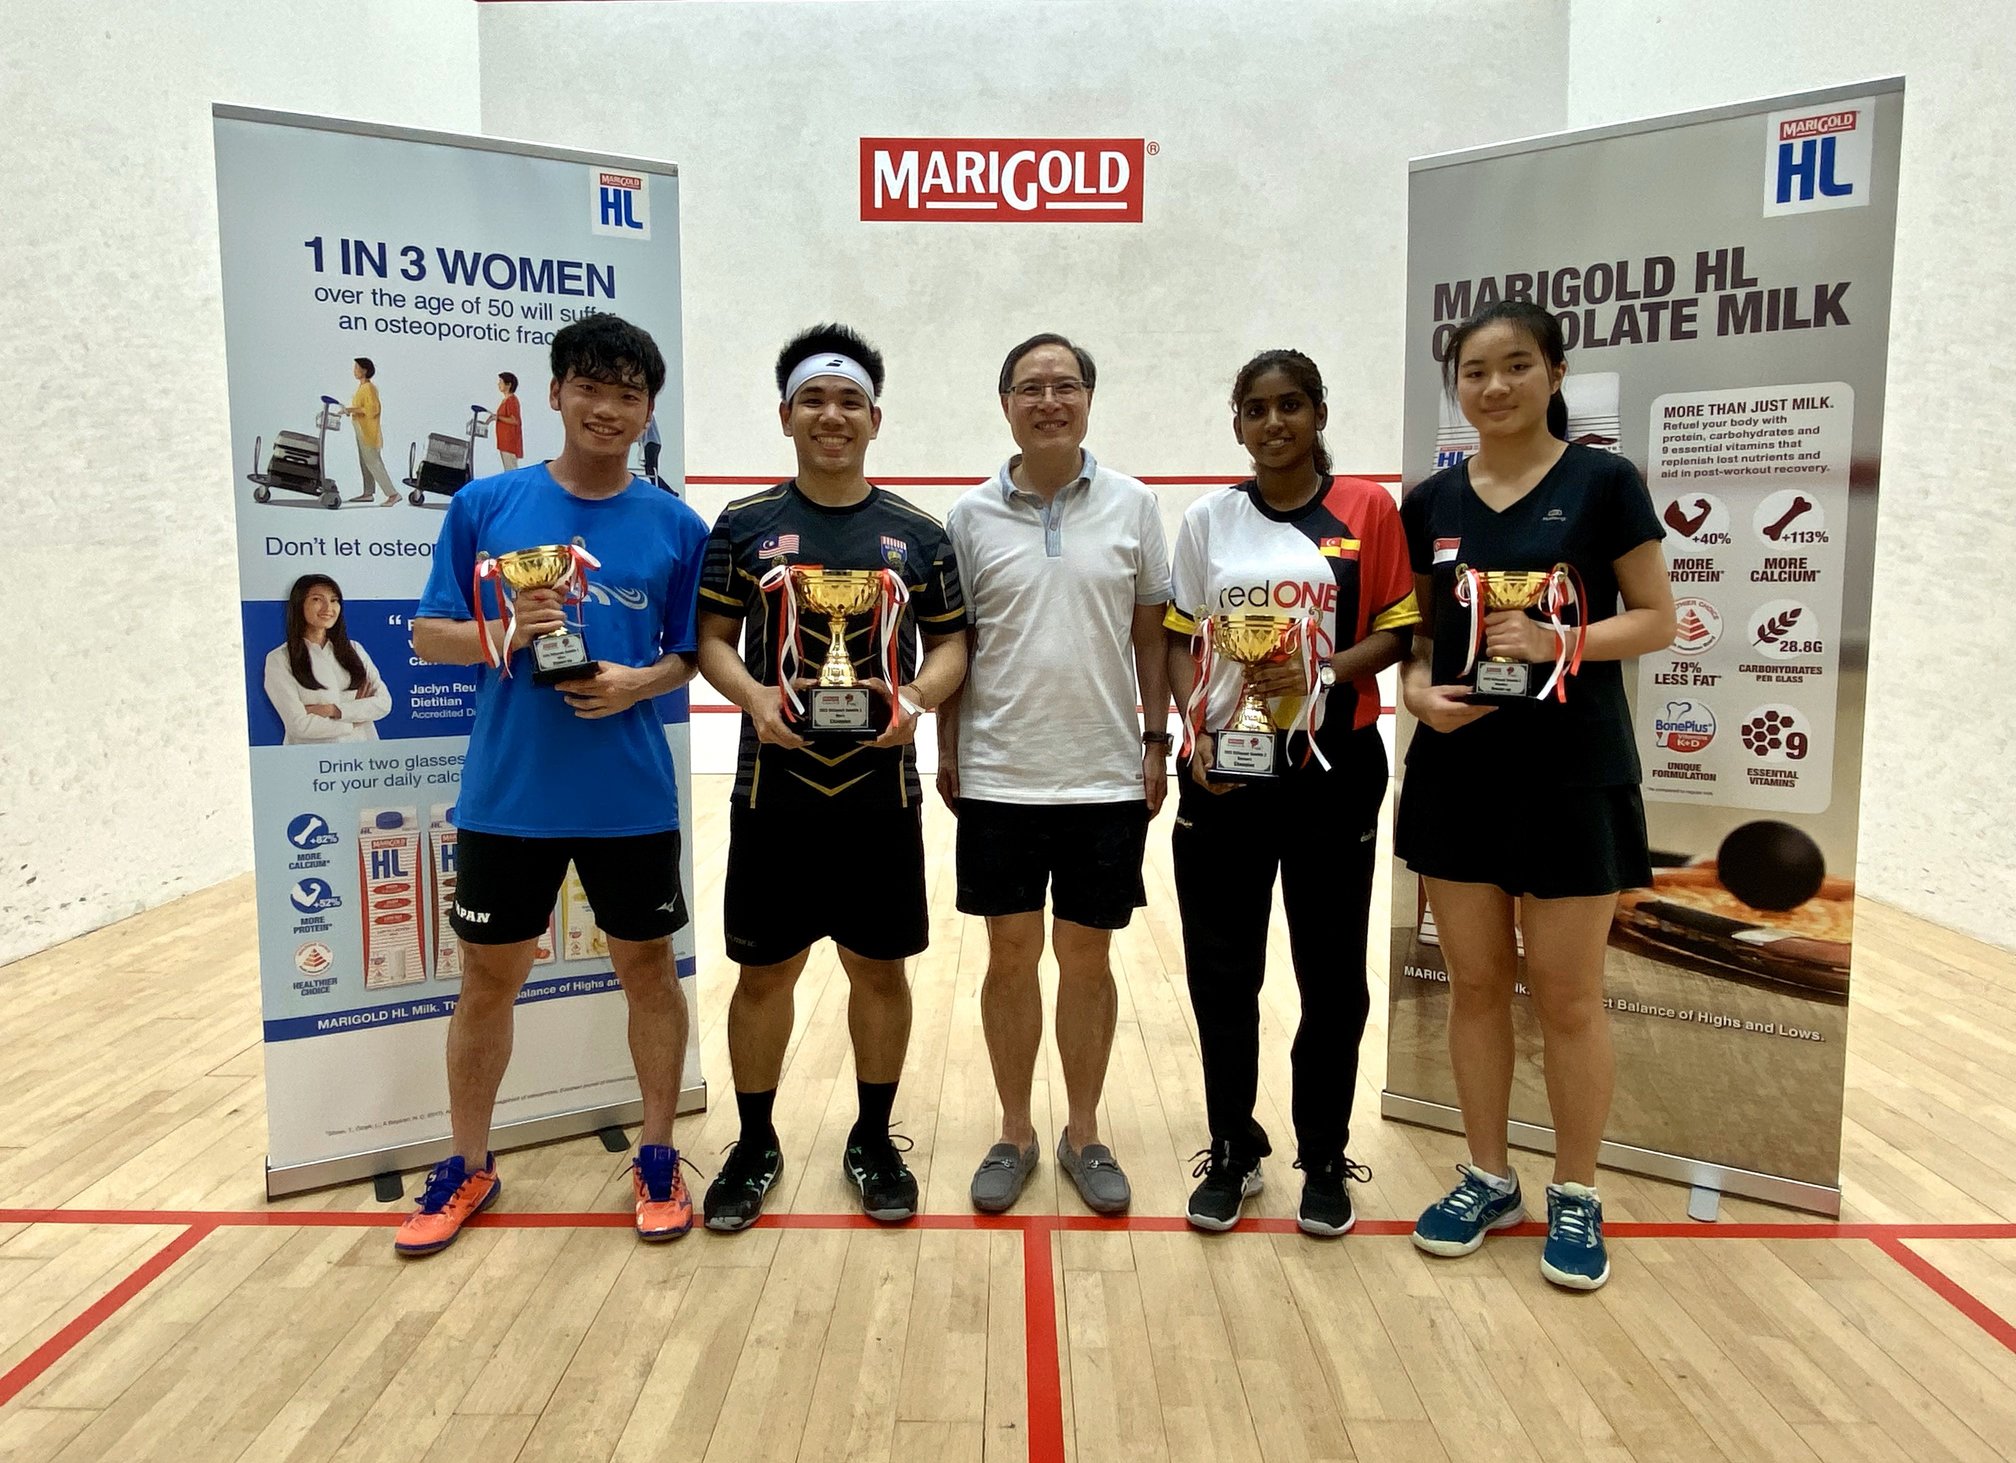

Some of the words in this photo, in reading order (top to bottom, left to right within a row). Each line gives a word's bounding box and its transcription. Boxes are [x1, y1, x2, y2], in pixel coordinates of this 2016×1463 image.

[1783, 113, 1854, 138] MARIGOLD
[1776, 136, 1854, 205] HL
[601, 174, 641, 188] MARIGOLD
[874, 150, 1130, 211] MARIGOLD
[600, 188, 643, 229] HL
[305, 236, 324, 272] 1
[341, 238, 388, 278] IN
[400, 246, 427, 282] 3
[436, 247, 616, 299] WOMEN
[1433, 256, 1676, 322] MARIGOLD
[1695, 247, 1758, 294] HL
[314, 287, 363, 304] over
[371, 288, 406, 307] the
[415, 296, 454, 315] age
[461, 297, 481, 315] of
[489, 299, 514, 318] 50
[521, 303, 553, 321] will
[560, 305, 616, 324] suff
[1717, 281, 1852, 336] MILK
[339, 314, 367, 331] an
[375, 316, 511, 342] osteoporotic
[516, 325, 557, 346] frac
[1664, 404, 1705, 418] MORE
[1708, 402, 1747, 416] THAN
[1751, 399, 1788, 413] JUST
[1792, 396, 1835, 410] MILK.
[1663, 420, 1699, 431] Refuel
[1702, 421, 1728, 430] your
[1730, 416, 1759, 429] body
[1762, 415, 1788, 425] with
[1662, 432, 1706, 443] protein,
[1709, 428, 1794, 441] carbohydrates
[1797, 426, 1820, 435] and
[1662, 446, 1669, 454] 9
[1671, 443, 1723, 454] essential
[1725, 441, 1775, 451] vitamins
[1778, 439, 1802, 449] that
[1661, 456, 1714, 467] replenish
[1716, 455, 1739, 464] lost
[1741, 452, 1795, 463] nutrients
[1798, 451, 1821, 460] and
[1661, 469, 1678, 478] aid
[1681, 468, 1691, 477] in
[1693, 465, 1771, 478] post-workout
[1774, 464, 1831, 474] recovery.
[1692, 533, 1731, 545] +40%
[1782, 531, 1829, 543] +113%
[334, 537, 361, 556] let
[1673, 558, 1714, 570] MORE
[1764, 558, 1808, 570] MORE
[1667, 570, 1725, 582] ROTEIN
[1779, 640, 1823, 653] 28.8G
[1671, 662, 1702, 673] 79%
[1738, 664, 1823, 675] CARBOHYDRATES
[1654, 674, 1689, 686] LESS
[1775, 675, 1803, 683] GLASS
[410, 683, 449, 695] Jaclyn
[453, 683, 476, 692] Reu
[411, 696, 462, 707] Dietitian
[411, 709, 463, 719] Accredited
[1786, 732, 1808, 760] 9
[319, 759, 364, 774] Drink
[369, 758, 399, 770] two
[1668, 762, 1702, 771] UNIQUE
[1652, 769, 1717, 781] FORMULATION
[1747, 768, 1799, 779] ESSENTIAL
[312, 778, 337, 792] for
[342, 778, 379, 793] your
[384, 772, 422, 788] daily
[427, 770, 461, 784] calc
[1749, 778, 1796, 788] VITAMINS
[310, 833, 338, 844] +82%
[297, 852, 322, 861] MORE
[371, 849, 409, 880] HL
[313, 897, 341, 907] +52%
[300, 916, 325, 925] MORE
[293, 977, 338, 990] HEALTHIER
[559, 983, 570, 993] of
[573, 980, 604, 991] Highs
[607, 979, 620, 987] an
[301, 986, 330, 996] CHOICE
[317, 1011, 389, 1030] MARIGOLD
[392, 1007, 409, 1018] HL
[412, 1003, 440, 1015] Milk.
[1617, 999, 1675, 1018] Balance
[1679, 1009, 1694, 1020] of
[1698, 1011, 1741, 1028] Highs
[1745, 1021, 1774, 1034] and
[1779, 1024, 1825, 1042] Lows.
